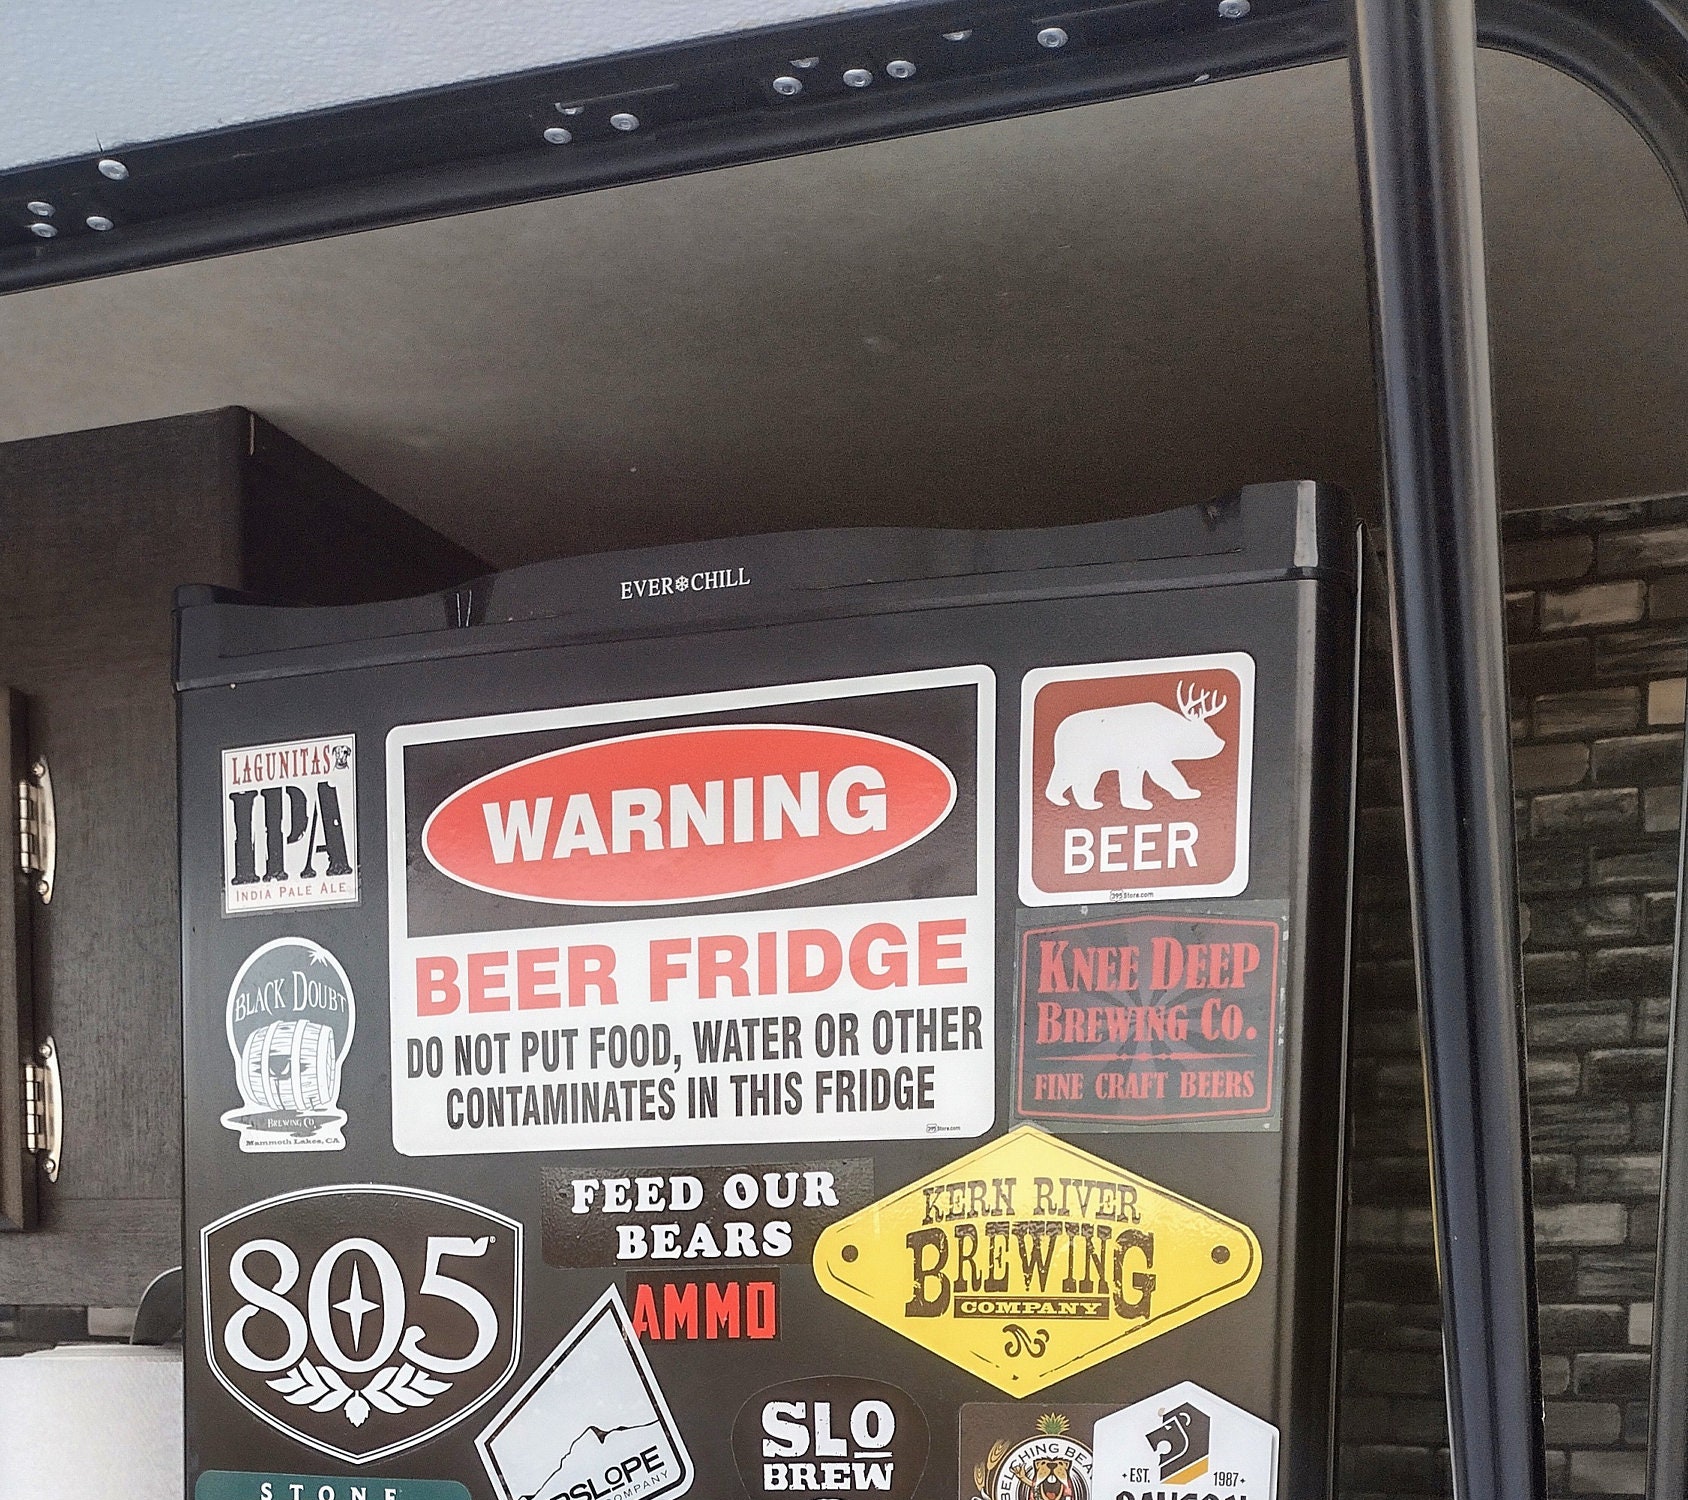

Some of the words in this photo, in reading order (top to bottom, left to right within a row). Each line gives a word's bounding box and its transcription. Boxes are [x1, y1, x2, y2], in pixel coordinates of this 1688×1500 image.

[620, 577, 674, 600] EVER
[691, 567, 751, 591] CHILL
[231, 744, 331, 785] LAGUNITAS
[229, 781, 353, 886] IPA
[482, 764, 887, 865] WARNING
[1064, 821, 1199, 875] BEER
[236, 889, 272, 902] INDIA
[279, 885, 312, 898] PALE
[320, 882, 346, 894] ALE
[415, 943, 619, 1017] BEER
[649, 918, 968, 1001] FRIDGE
[1038, 940, 1141, 993] KNEE
[1150, 936, 1260, 990] DEEP
[235, 978, 286, 1022] BLACK
[292, 970, 346, 1013] DOUBT
[407, 1036, 443, 1079] DO
[455, 1032, 510, 1075] NOT
[521, 1027, 579, 1073] PUT
[590, 1022, 681, 1073] FOOD,
[693, 1015, 802, 1064] WATER
[814, 1011, 859, 1058] OR
[872, 1005, 983, 1055] OTHER
[1036, 1001, 1189, 1045] BREWING
[446, 1077, 676, 1129] CONTAMINATES
[688, 1075, 718, 1119] IN
[729, 1071, 803, 1117] THIS
[815, 1065, 936, 1113] FRIDGE
[1034, 1073, 1084, 1100] FINE
[1095, 1071, 1169, 1099] CRAFT
[1180, 1070, 1255, 1099] BEERS
[571, 1175, 704, 1214] FEED
[723, 1170, 840, 1210] OUR
[922, 1177, 1016, 1226] KERN
[1033, 1176, 1142, 1225] RIVER
[615, 1220, 793, 1260] BEARS
[905, 1221, 1157, 1319] BREWING
[633, 1281, 776, 1340] AMMO
[960, 1301, 1102, 1316] COMPANY
[761, 1399, 896, 1458] SLO
[763, 1462, 895, 1491] BREW
[1064, 1446, 1093, 1479] BEA
[1129, 1467, 1150, 1483] EST.
[1213, 1472, 1239, 1487] 1987
